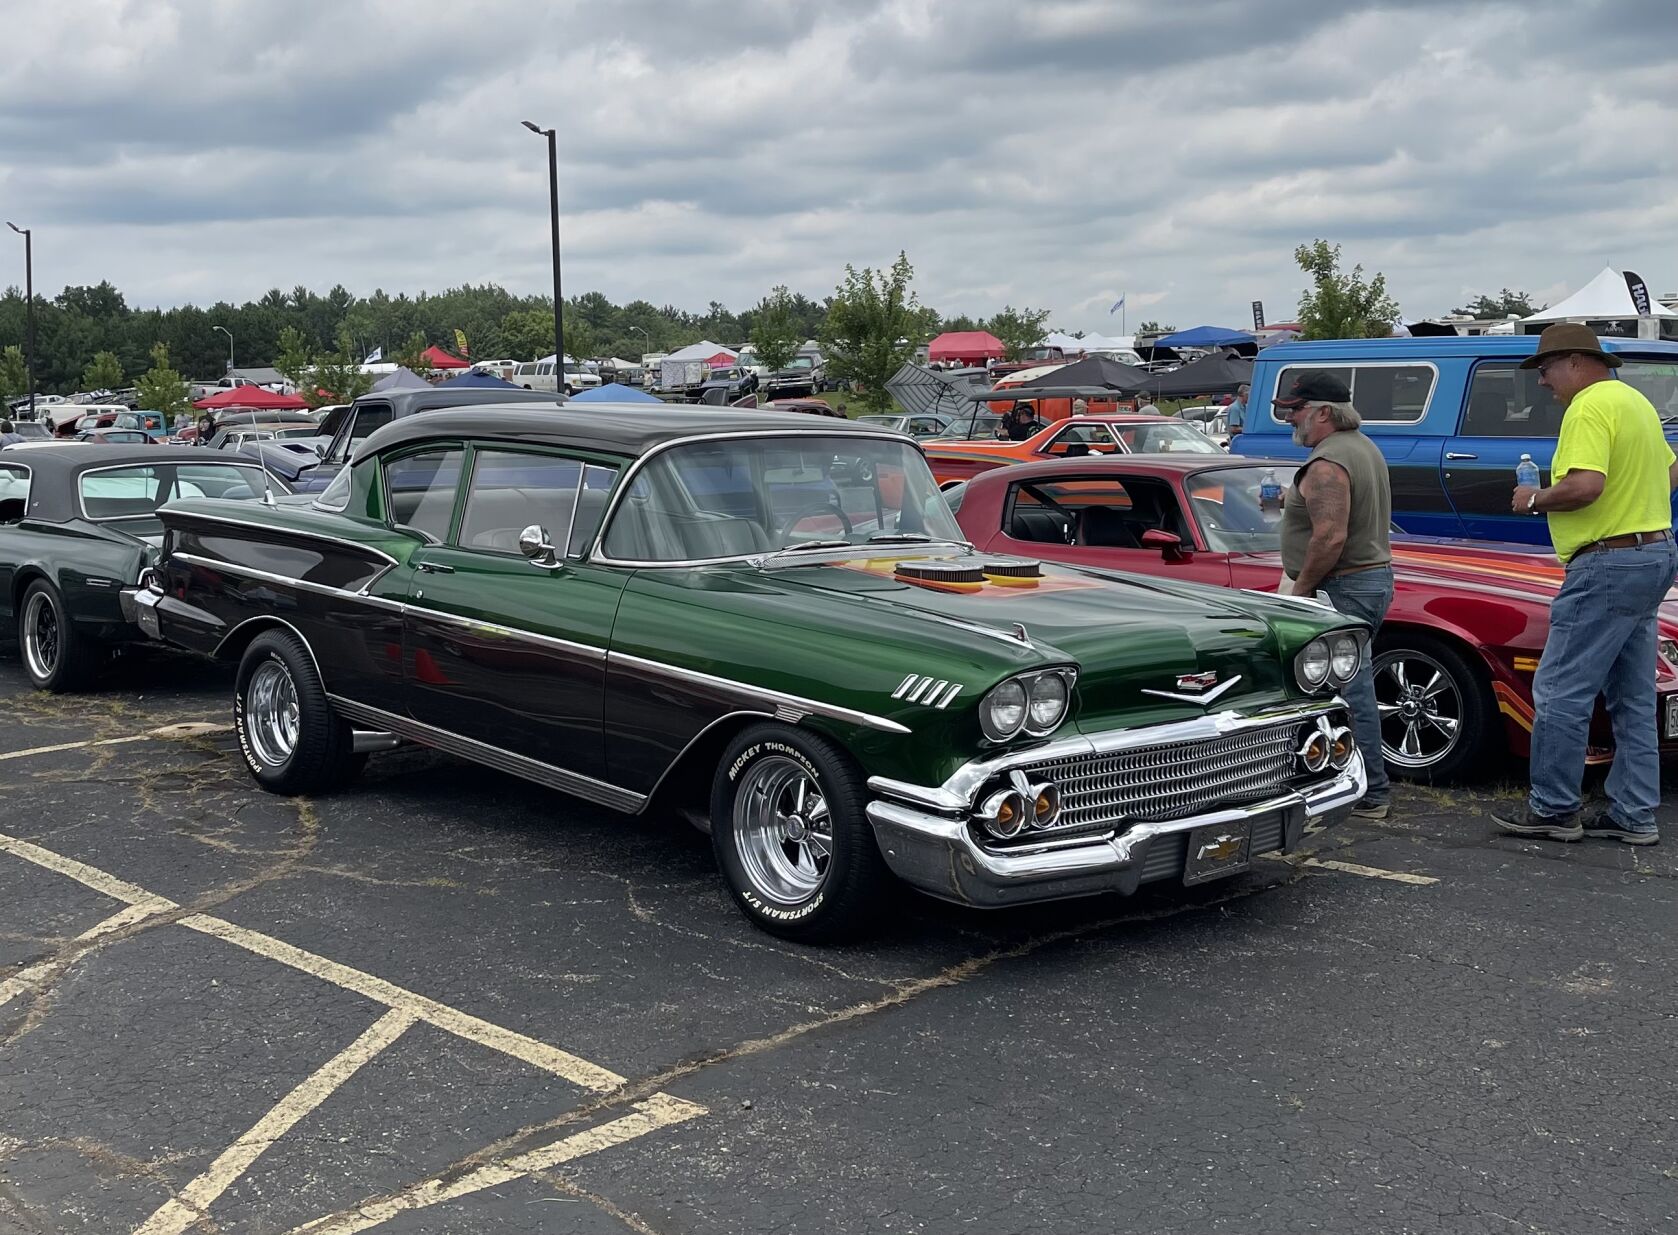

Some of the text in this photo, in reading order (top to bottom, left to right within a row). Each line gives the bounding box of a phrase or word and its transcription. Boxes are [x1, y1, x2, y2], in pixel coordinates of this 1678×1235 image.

[235, 692, 263, 773] SPORTSMAN S/T
[728, 742, 820, 781] MICKEY THOMPSON
[742, 891, 824, 920] SPORTSMAN S/T
